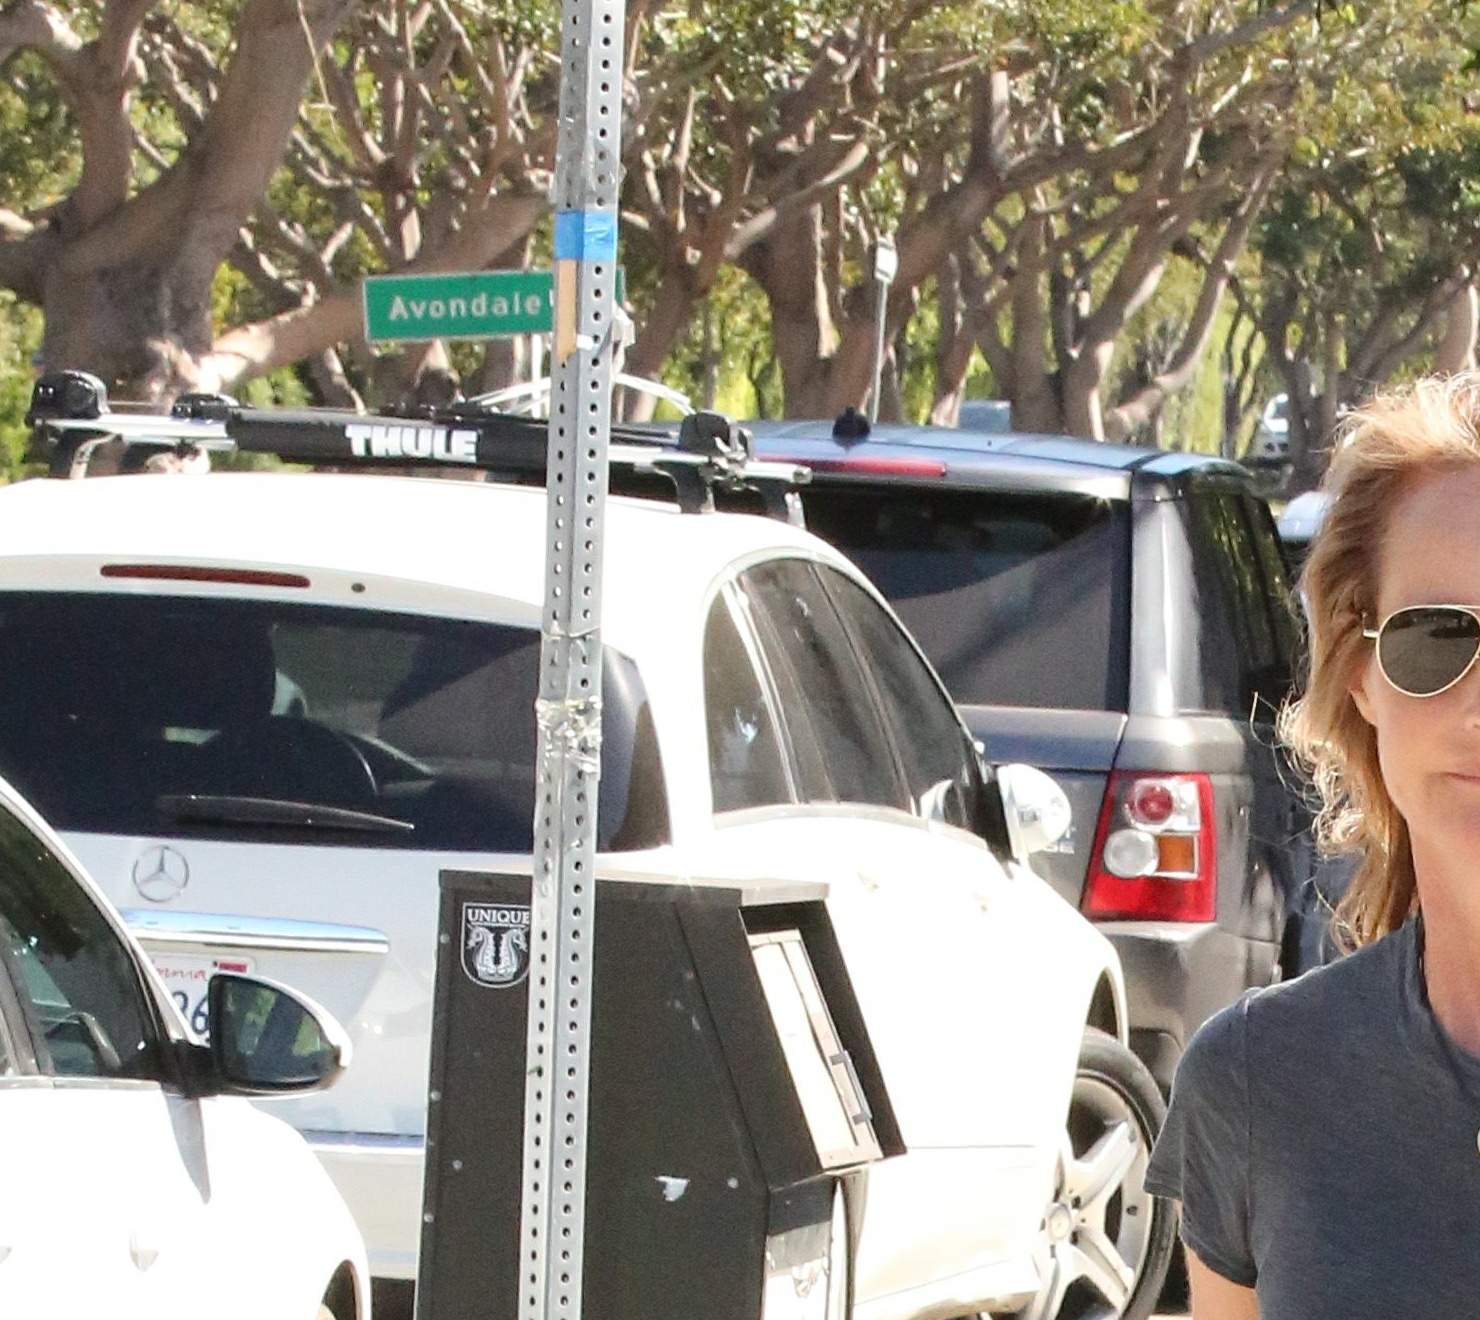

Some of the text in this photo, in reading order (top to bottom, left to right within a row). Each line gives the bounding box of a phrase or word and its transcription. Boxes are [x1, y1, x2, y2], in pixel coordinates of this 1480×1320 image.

[389, 292, 541, 321] Avondale
[345, 424, 477, 462] THULE
[467, 908, 530, 925] UNIQUE
